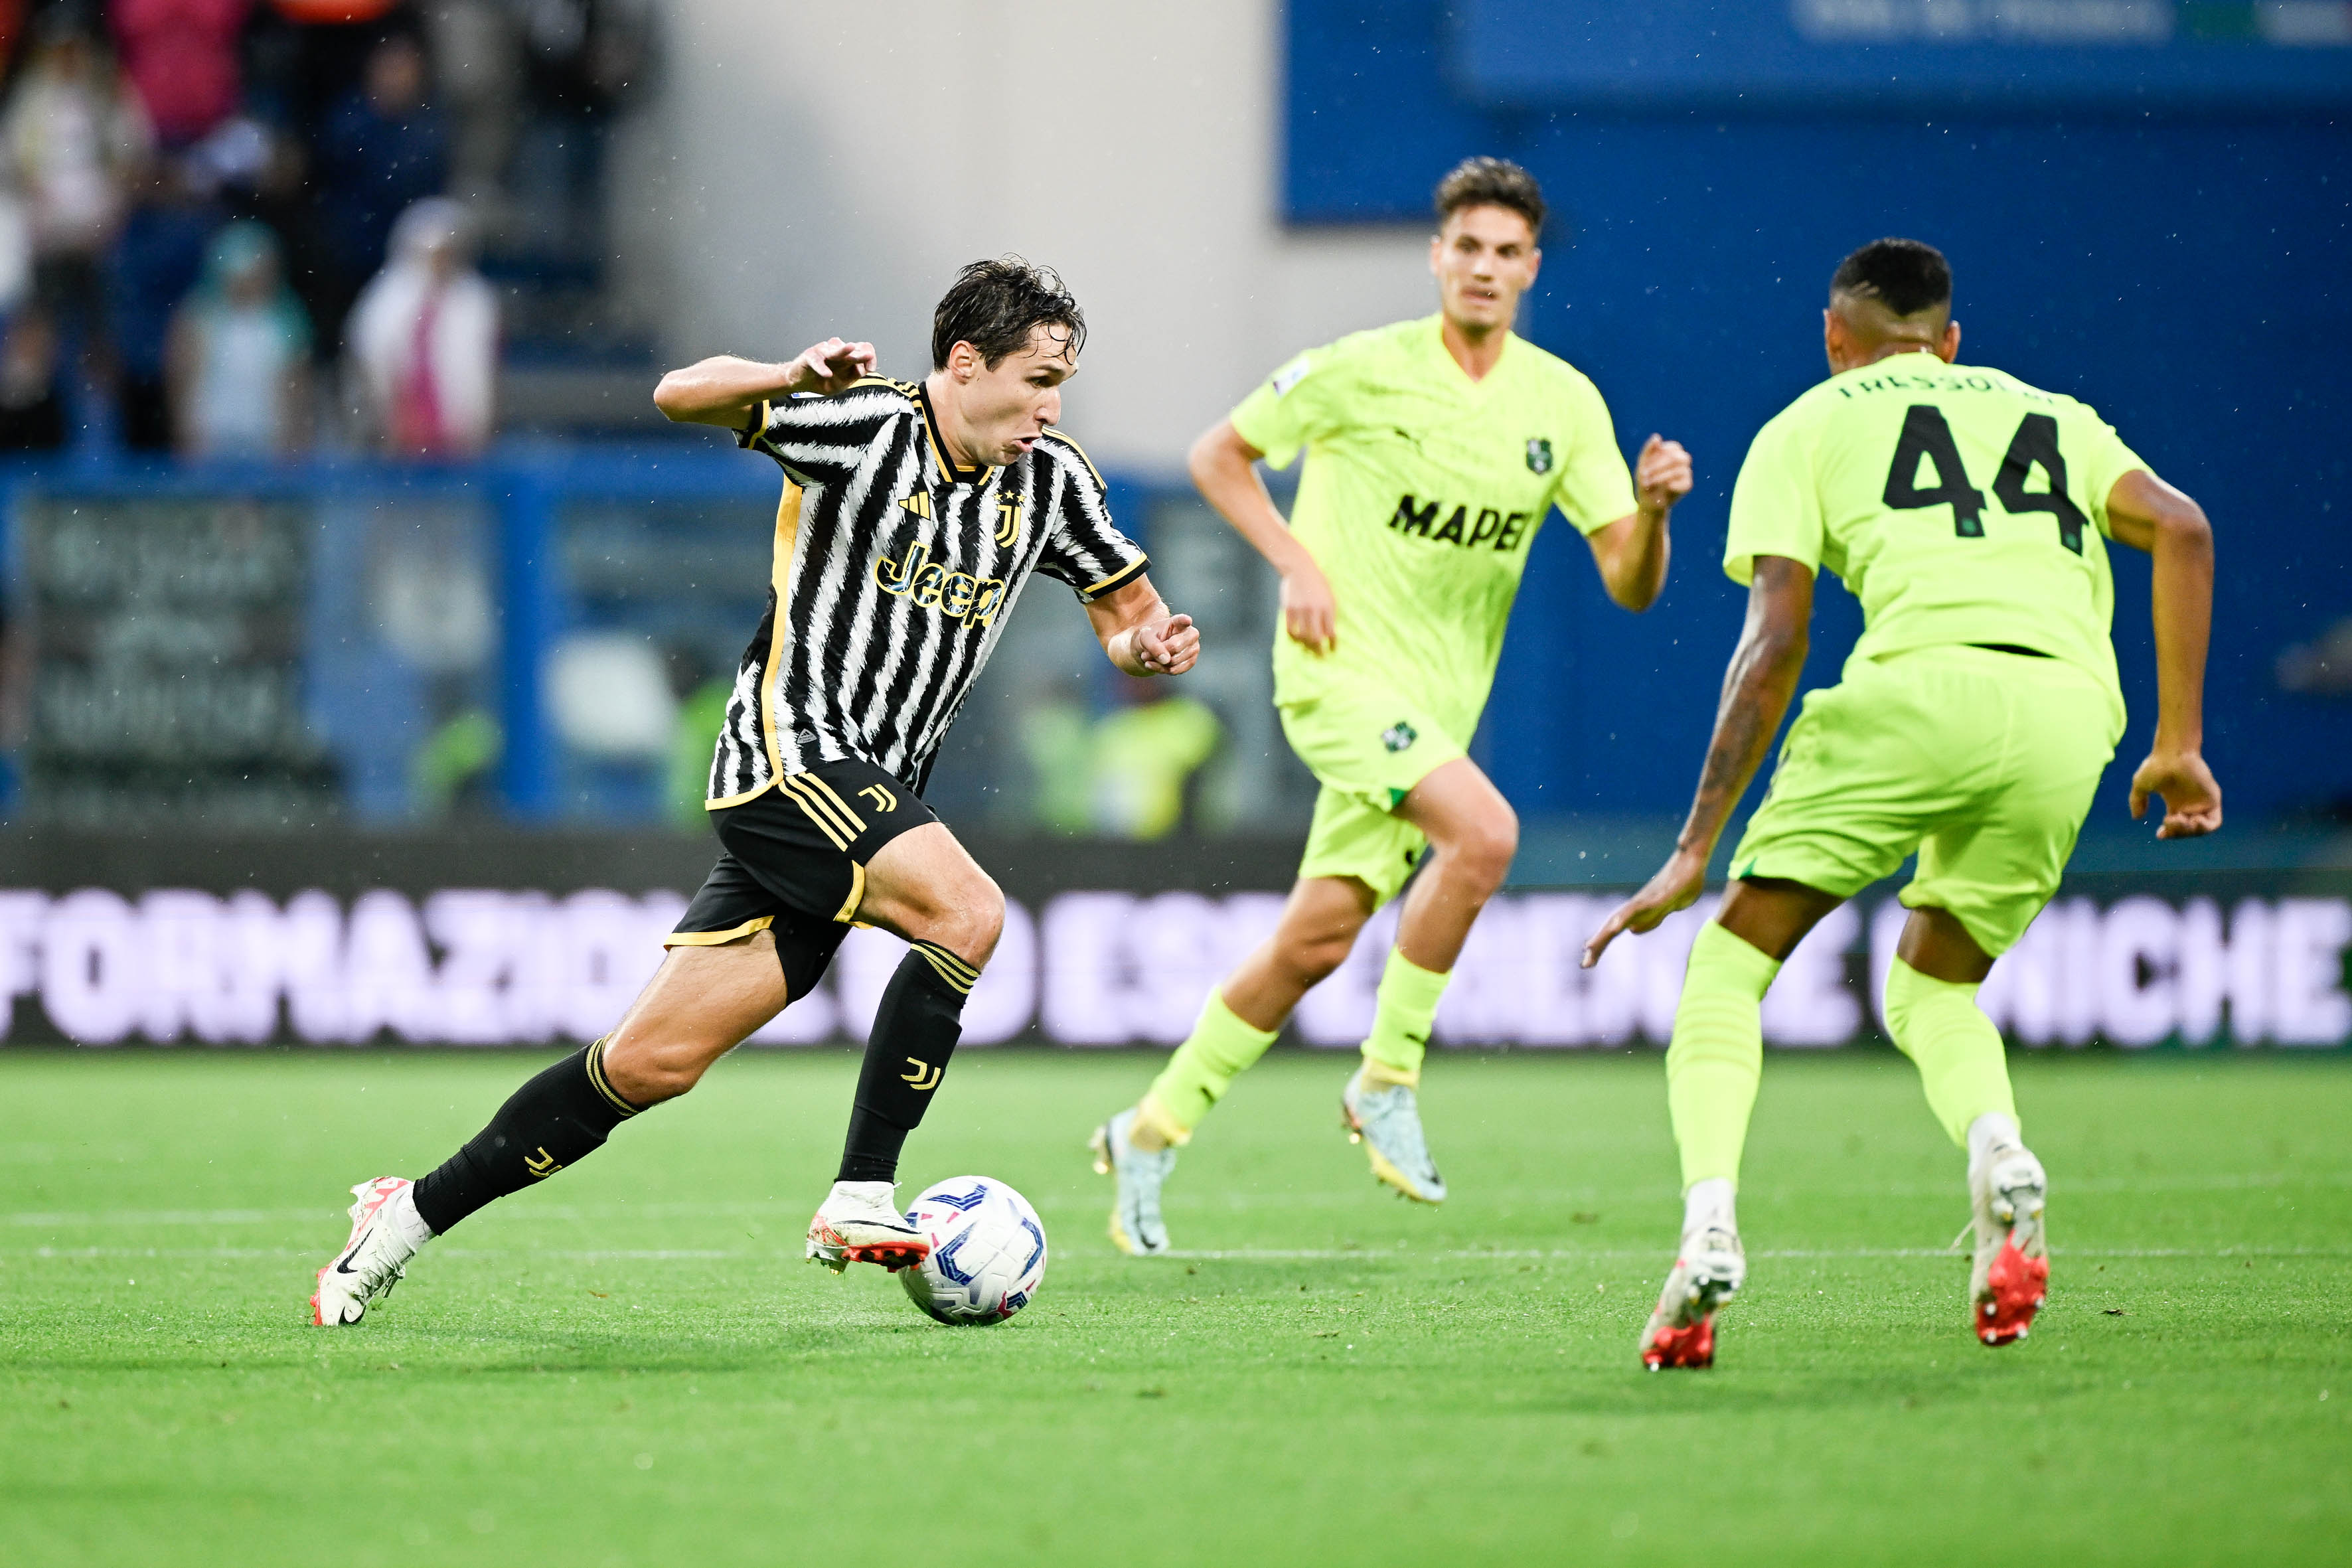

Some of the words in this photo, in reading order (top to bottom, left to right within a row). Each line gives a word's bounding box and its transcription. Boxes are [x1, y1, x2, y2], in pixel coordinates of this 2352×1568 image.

[1388, 494, 1533, 551] MAPE
[1883, 404, 2089, 557] 44
[874, 540, 1006, 629] Jeep
